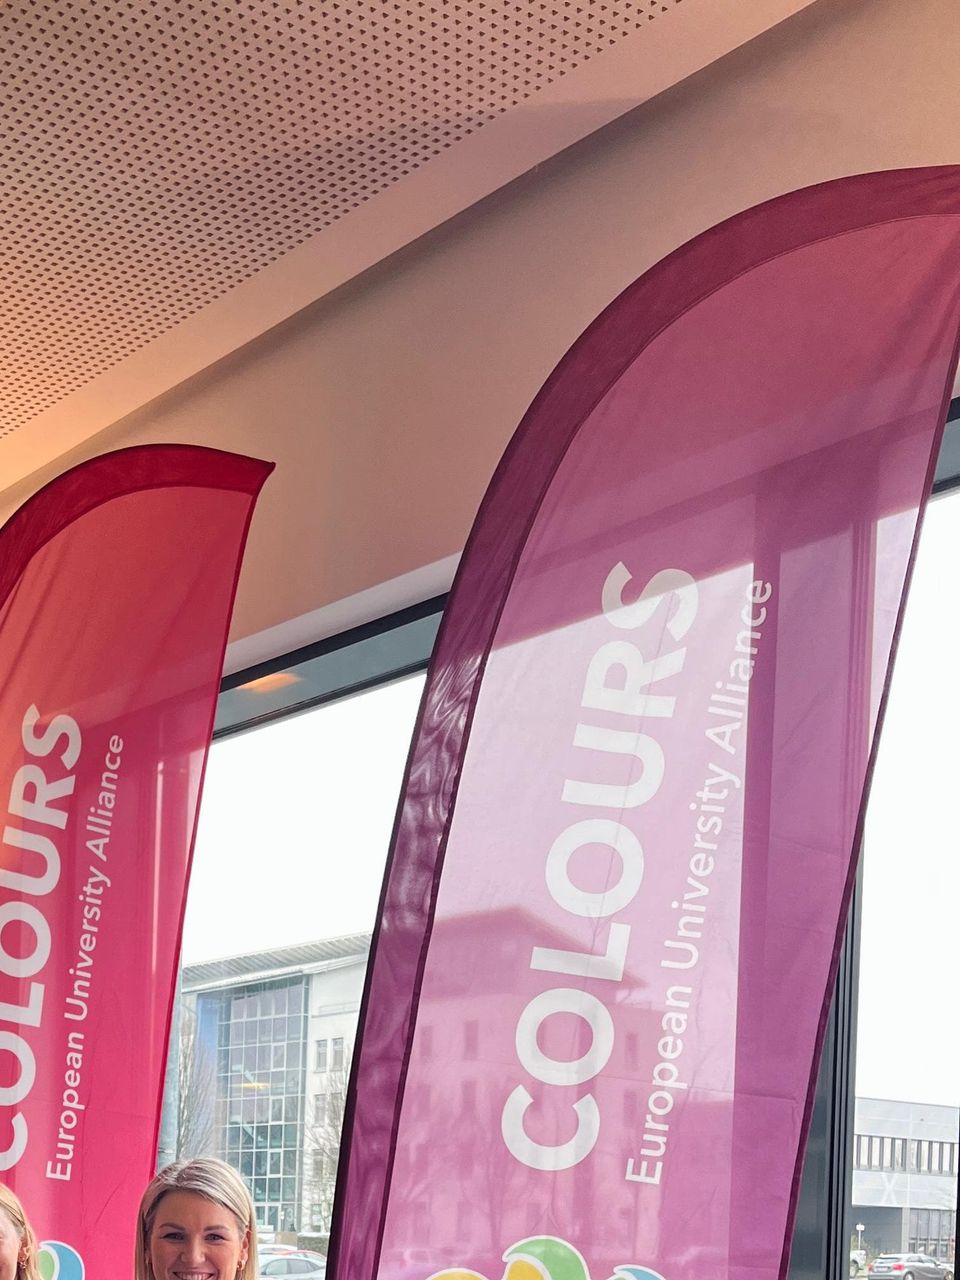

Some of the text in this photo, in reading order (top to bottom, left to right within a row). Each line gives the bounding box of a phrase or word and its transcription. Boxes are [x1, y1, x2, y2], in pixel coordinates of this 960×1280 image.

[46, 734, 124, 1181] European University Alliance
[501, 561, 699, 1171] COLOURS
[625, 580, 771, 1185] European University Alliance
